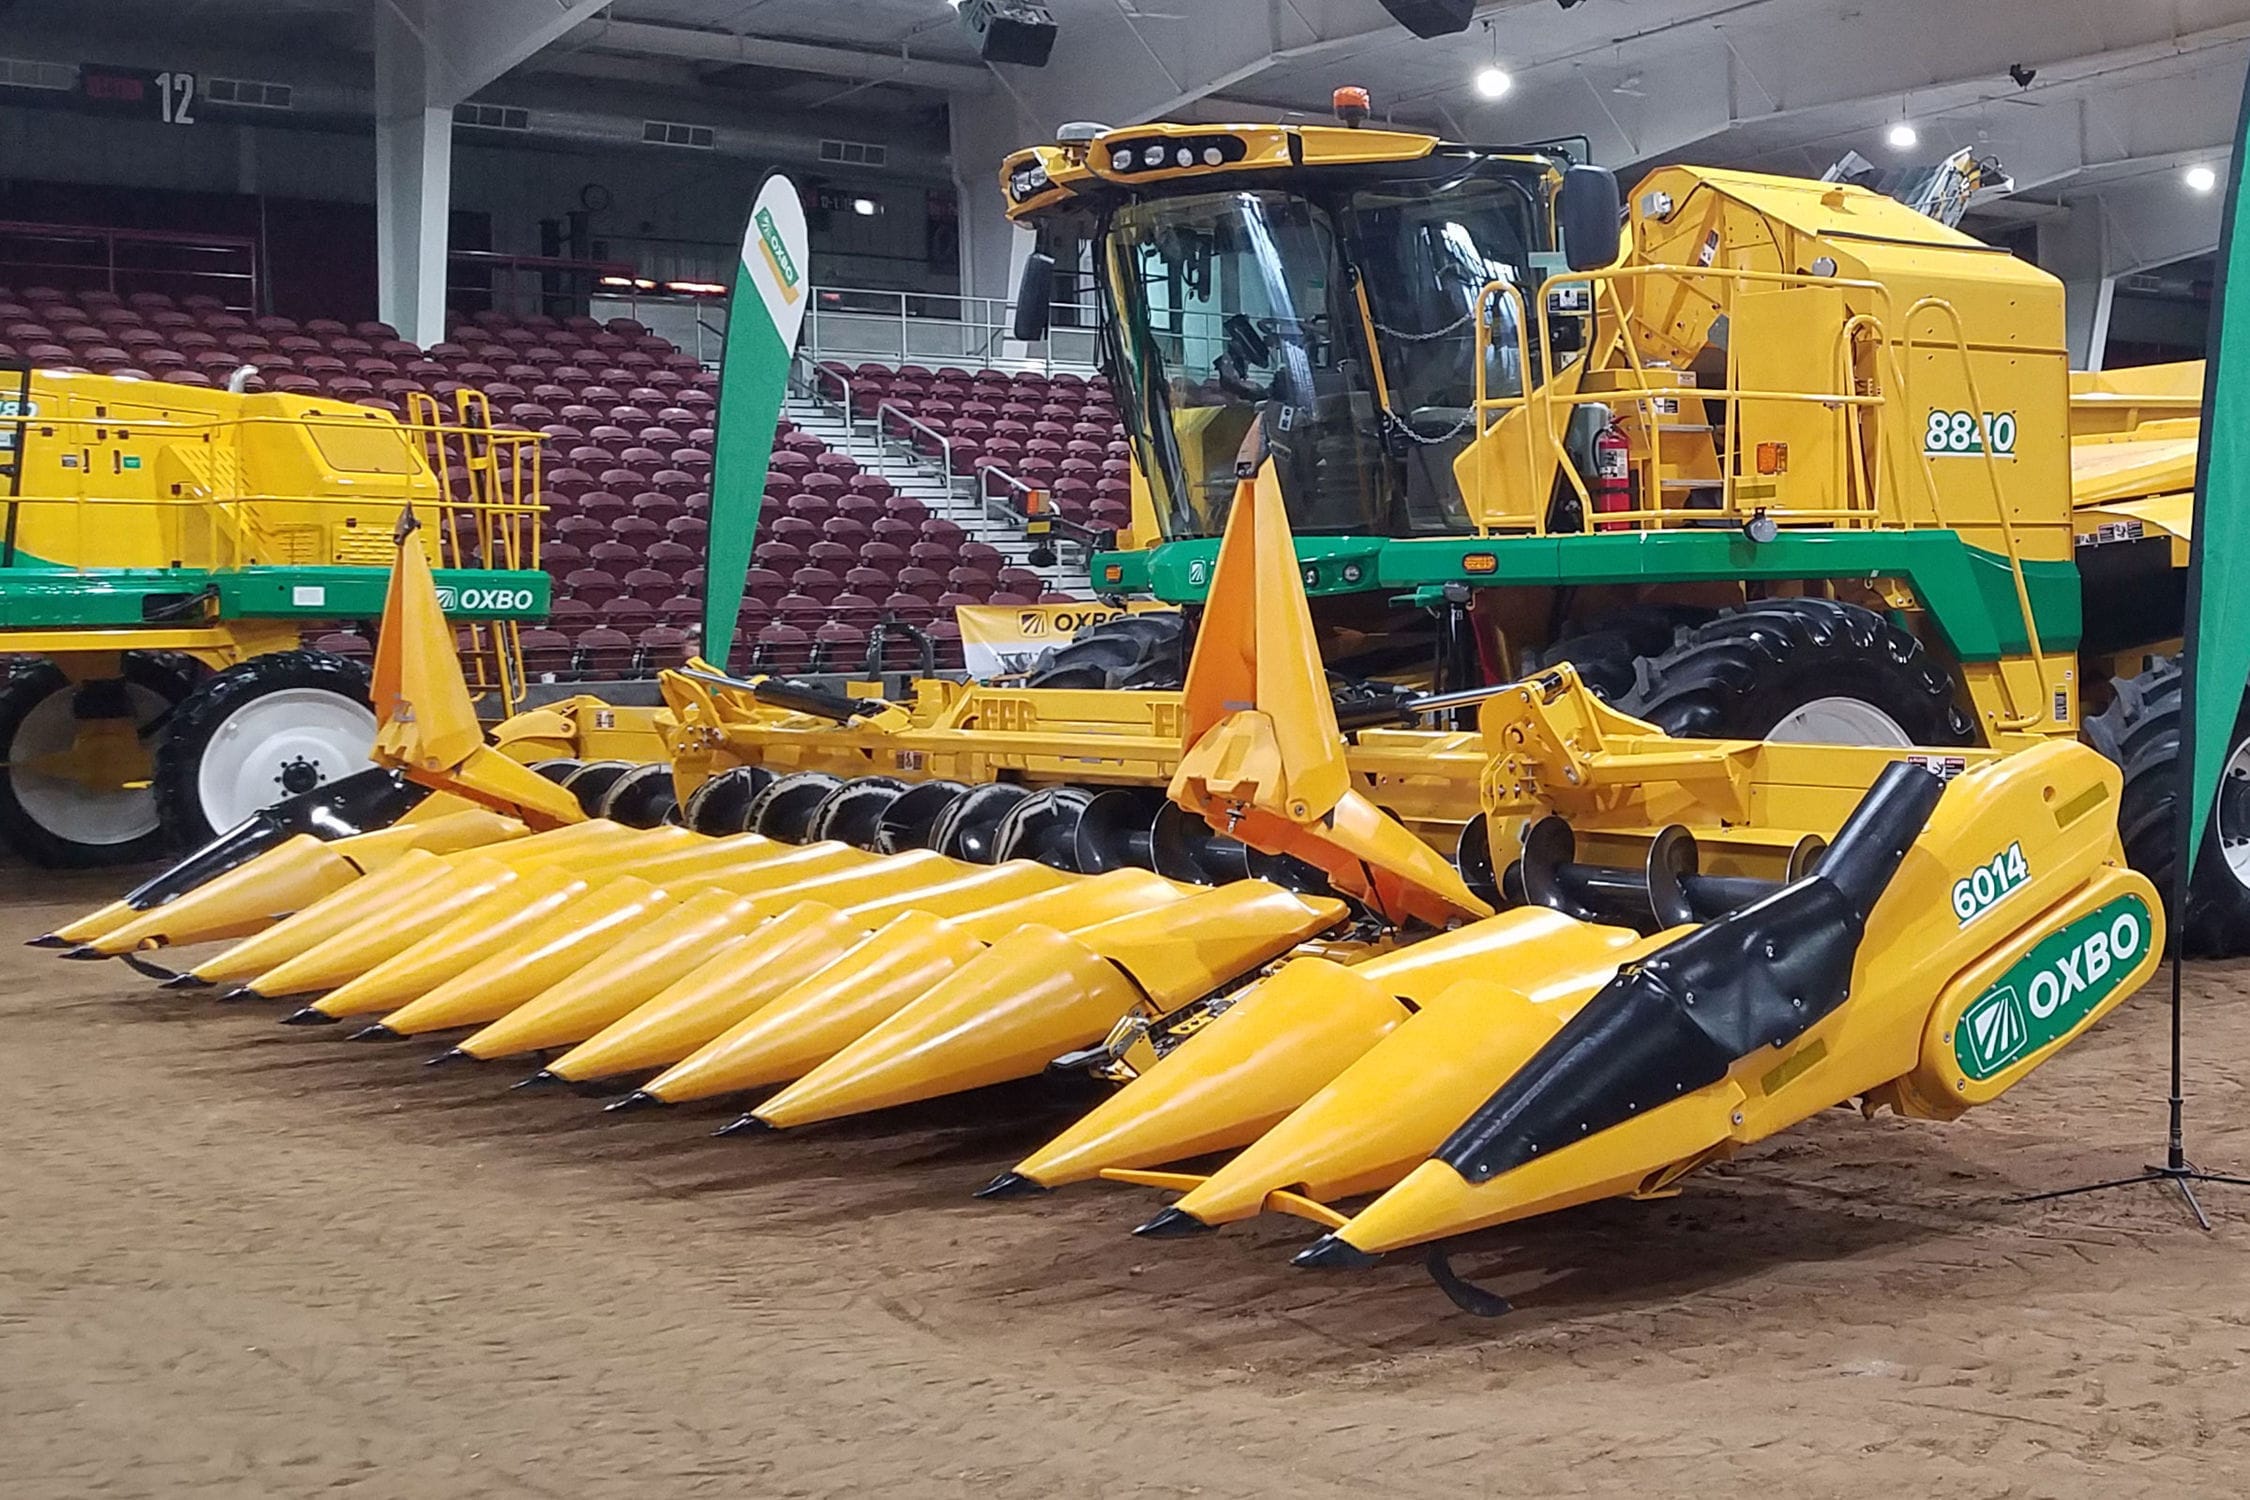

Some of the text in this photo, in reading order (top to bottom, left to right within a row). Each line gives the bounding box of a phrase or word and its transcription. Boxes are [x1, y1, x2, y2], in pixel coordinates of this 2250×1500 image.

[155, 72, 194, 124] 12
[770, 235, 793, 281] OXBO
[1925, 410, 2016, 452] 8840
[460, 588, 533, 610] OXBO
[1952, 841, 2029, 920] 6014
[2028, 913, 2140, 1019] OXBO
